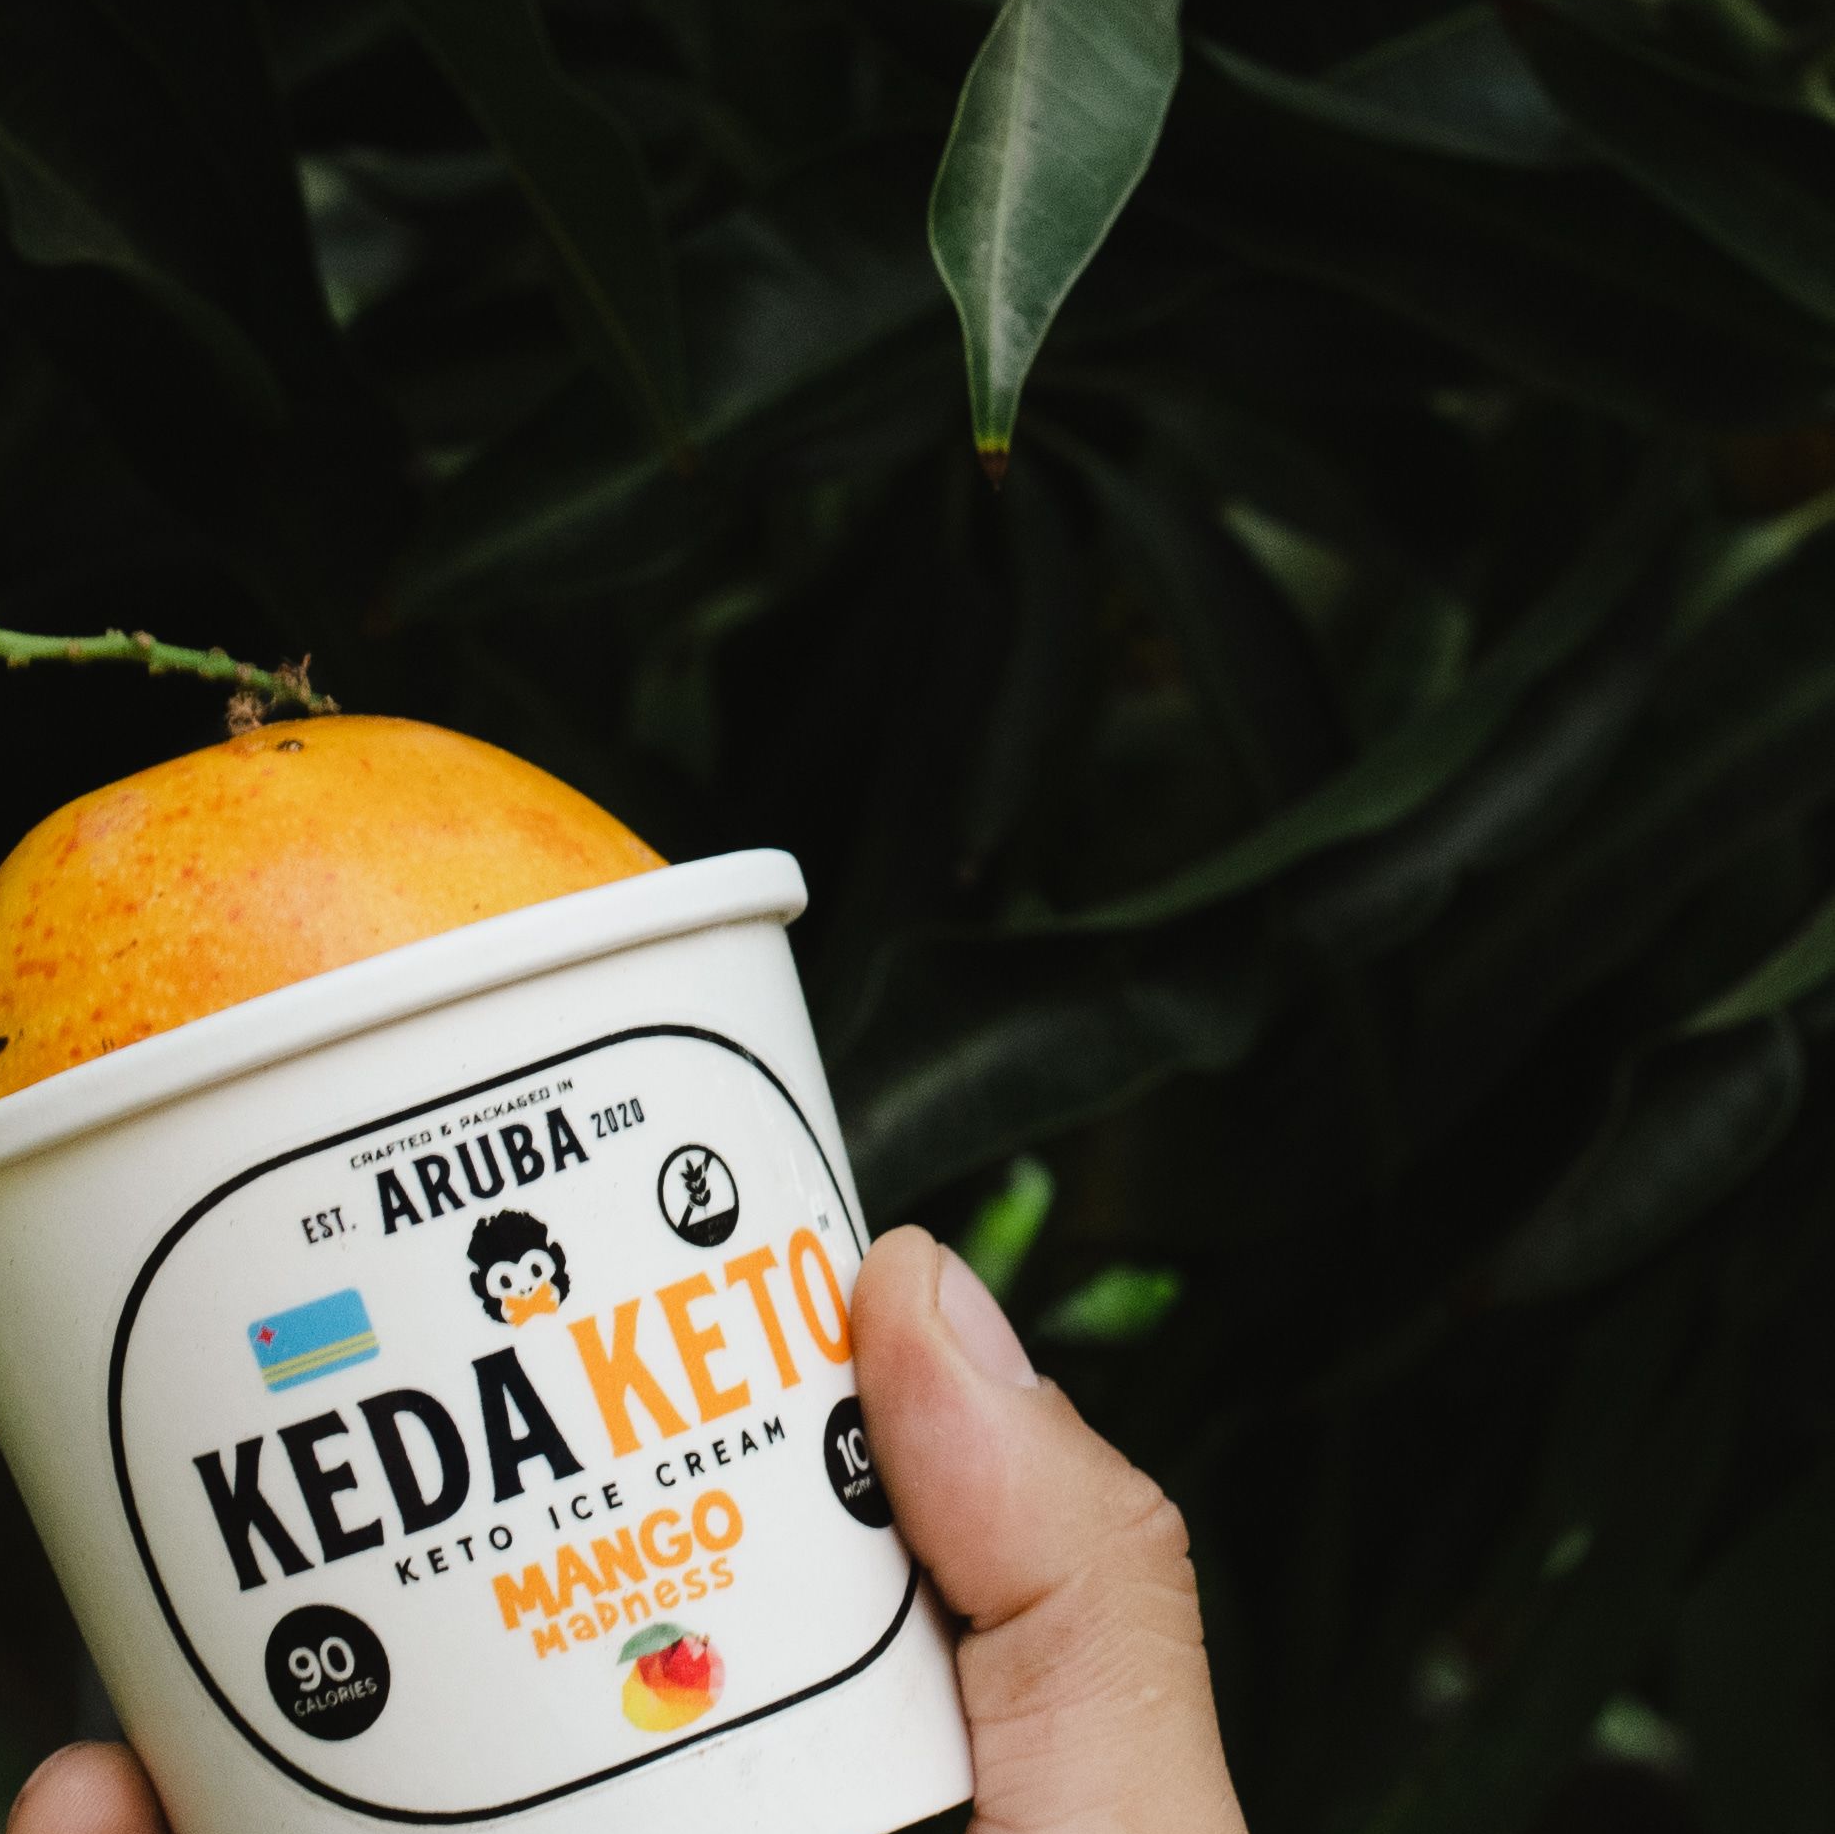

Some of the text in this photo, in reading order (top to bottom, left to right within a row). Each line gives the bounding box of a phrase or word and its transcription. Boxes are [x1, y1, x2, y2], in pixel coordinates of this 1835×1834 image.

[301, 1096, 646, 1245] EST. ARUBA 2020
[350, 1077, 574, 1169] CRAFTED & PACKAGED IN
[193, 1345, 586, 1592] KEDA
[567, 1226, 854, 1459] KETO
[394, 1415, 787, 1586] KETO ICE CREAM
[491, 1487, 745, 1632] MANGO
[288, 1635, 355, 1693] 90
[294, 1676, 378, 1718] CALORIES
